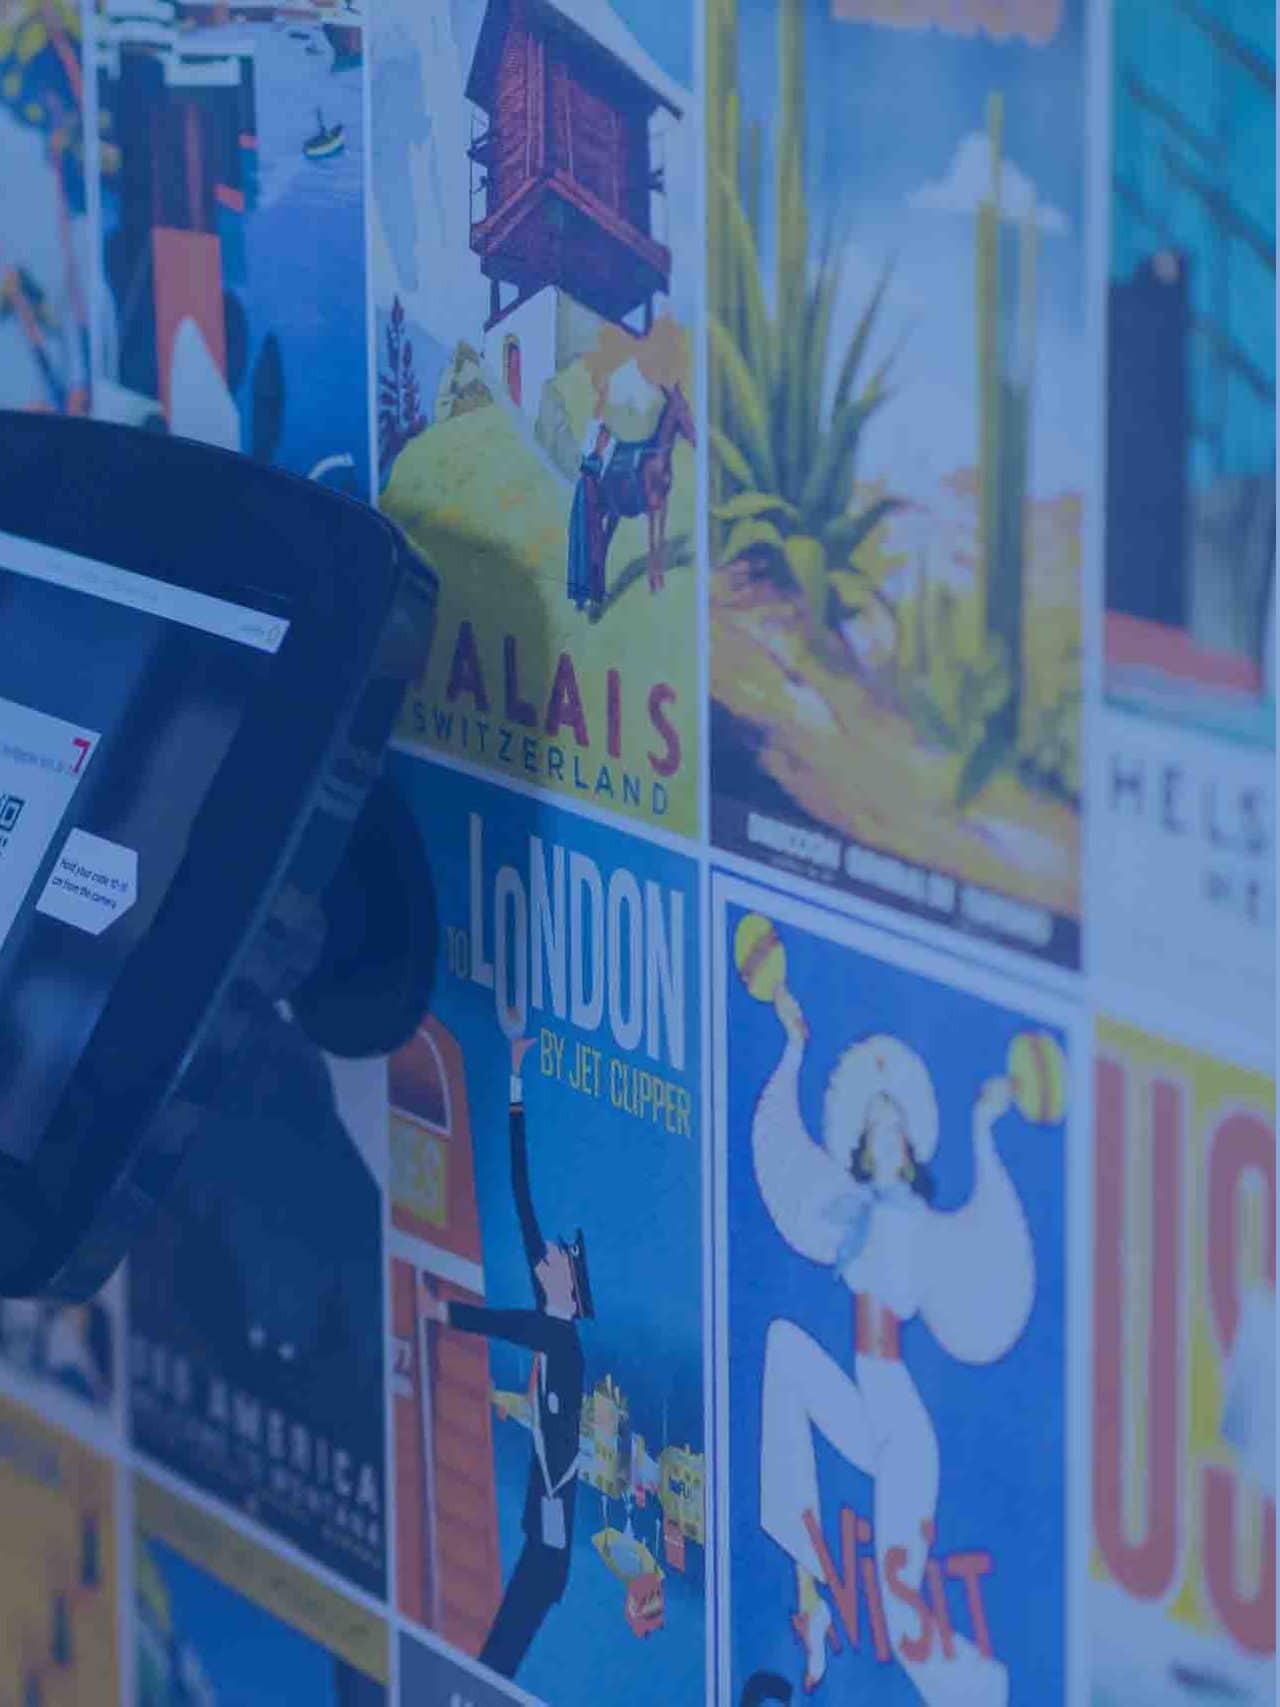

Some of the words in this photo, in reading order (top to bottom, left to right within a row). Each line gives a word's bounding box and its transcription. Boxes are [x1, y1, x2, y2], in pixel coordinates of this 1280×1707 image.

[411, 698, 669, 816] SWITZERLAND
[448, 924, 471, 980] TO
[469, 811, 686, 1072] LONDON
[539, 1027, 566, 1081] BY
[569, 1040, 602, 1098] JET
[610, 1058, 692, 1139] CLIPPER
